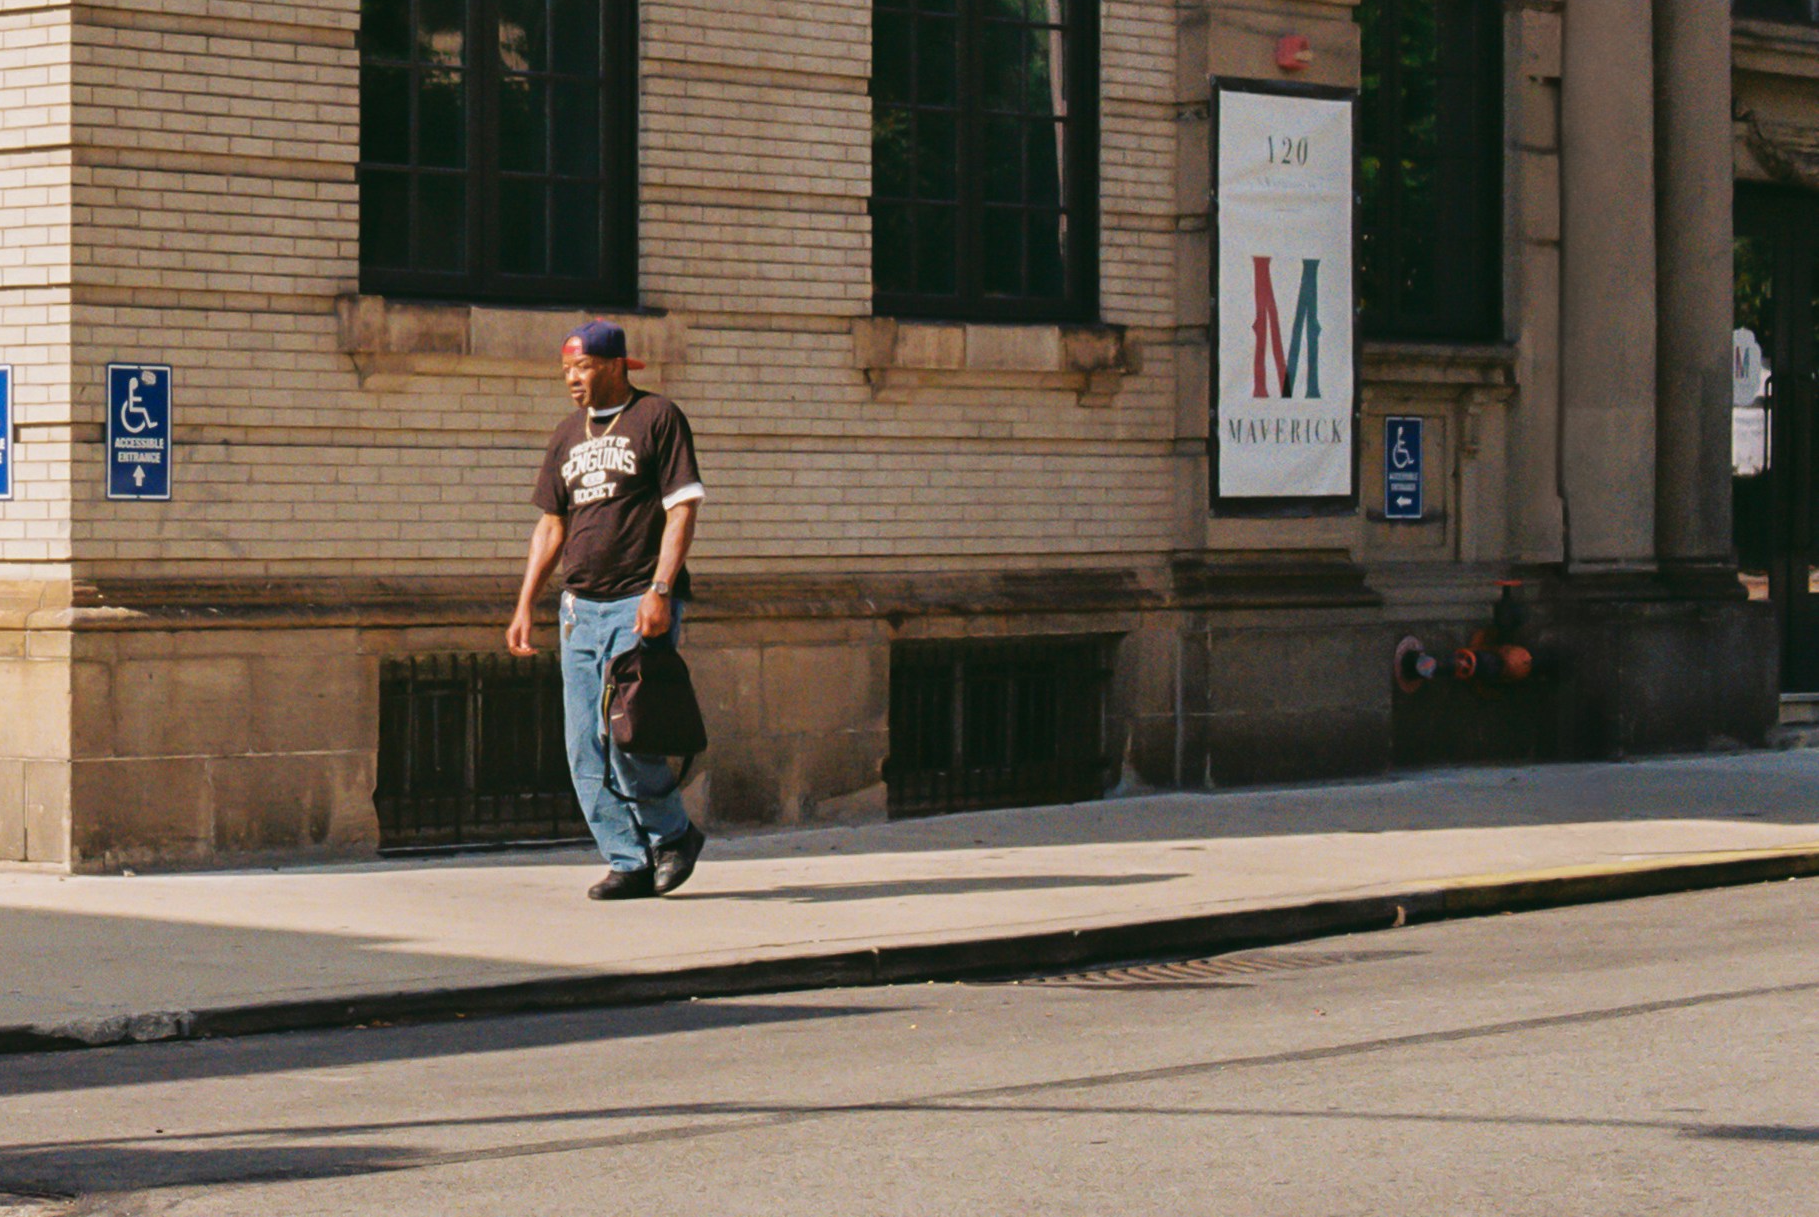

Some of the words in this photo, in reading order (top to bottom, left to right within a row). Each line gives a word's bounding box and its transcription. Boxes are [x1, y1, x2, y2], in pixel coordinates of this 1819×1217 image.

[1268, 135, 1309, 166] 120
[1251, 255, 1322, 399] M
[114, 437, 165, 449] ACCESSIBLE
[1228, 417, 1343, 444] MAVERICK
[117, 451, 161, 464] ENTRANCE
[561, 447, 637, 487] PENGUINS
[573, 482, 617, 504] HOCKEY
